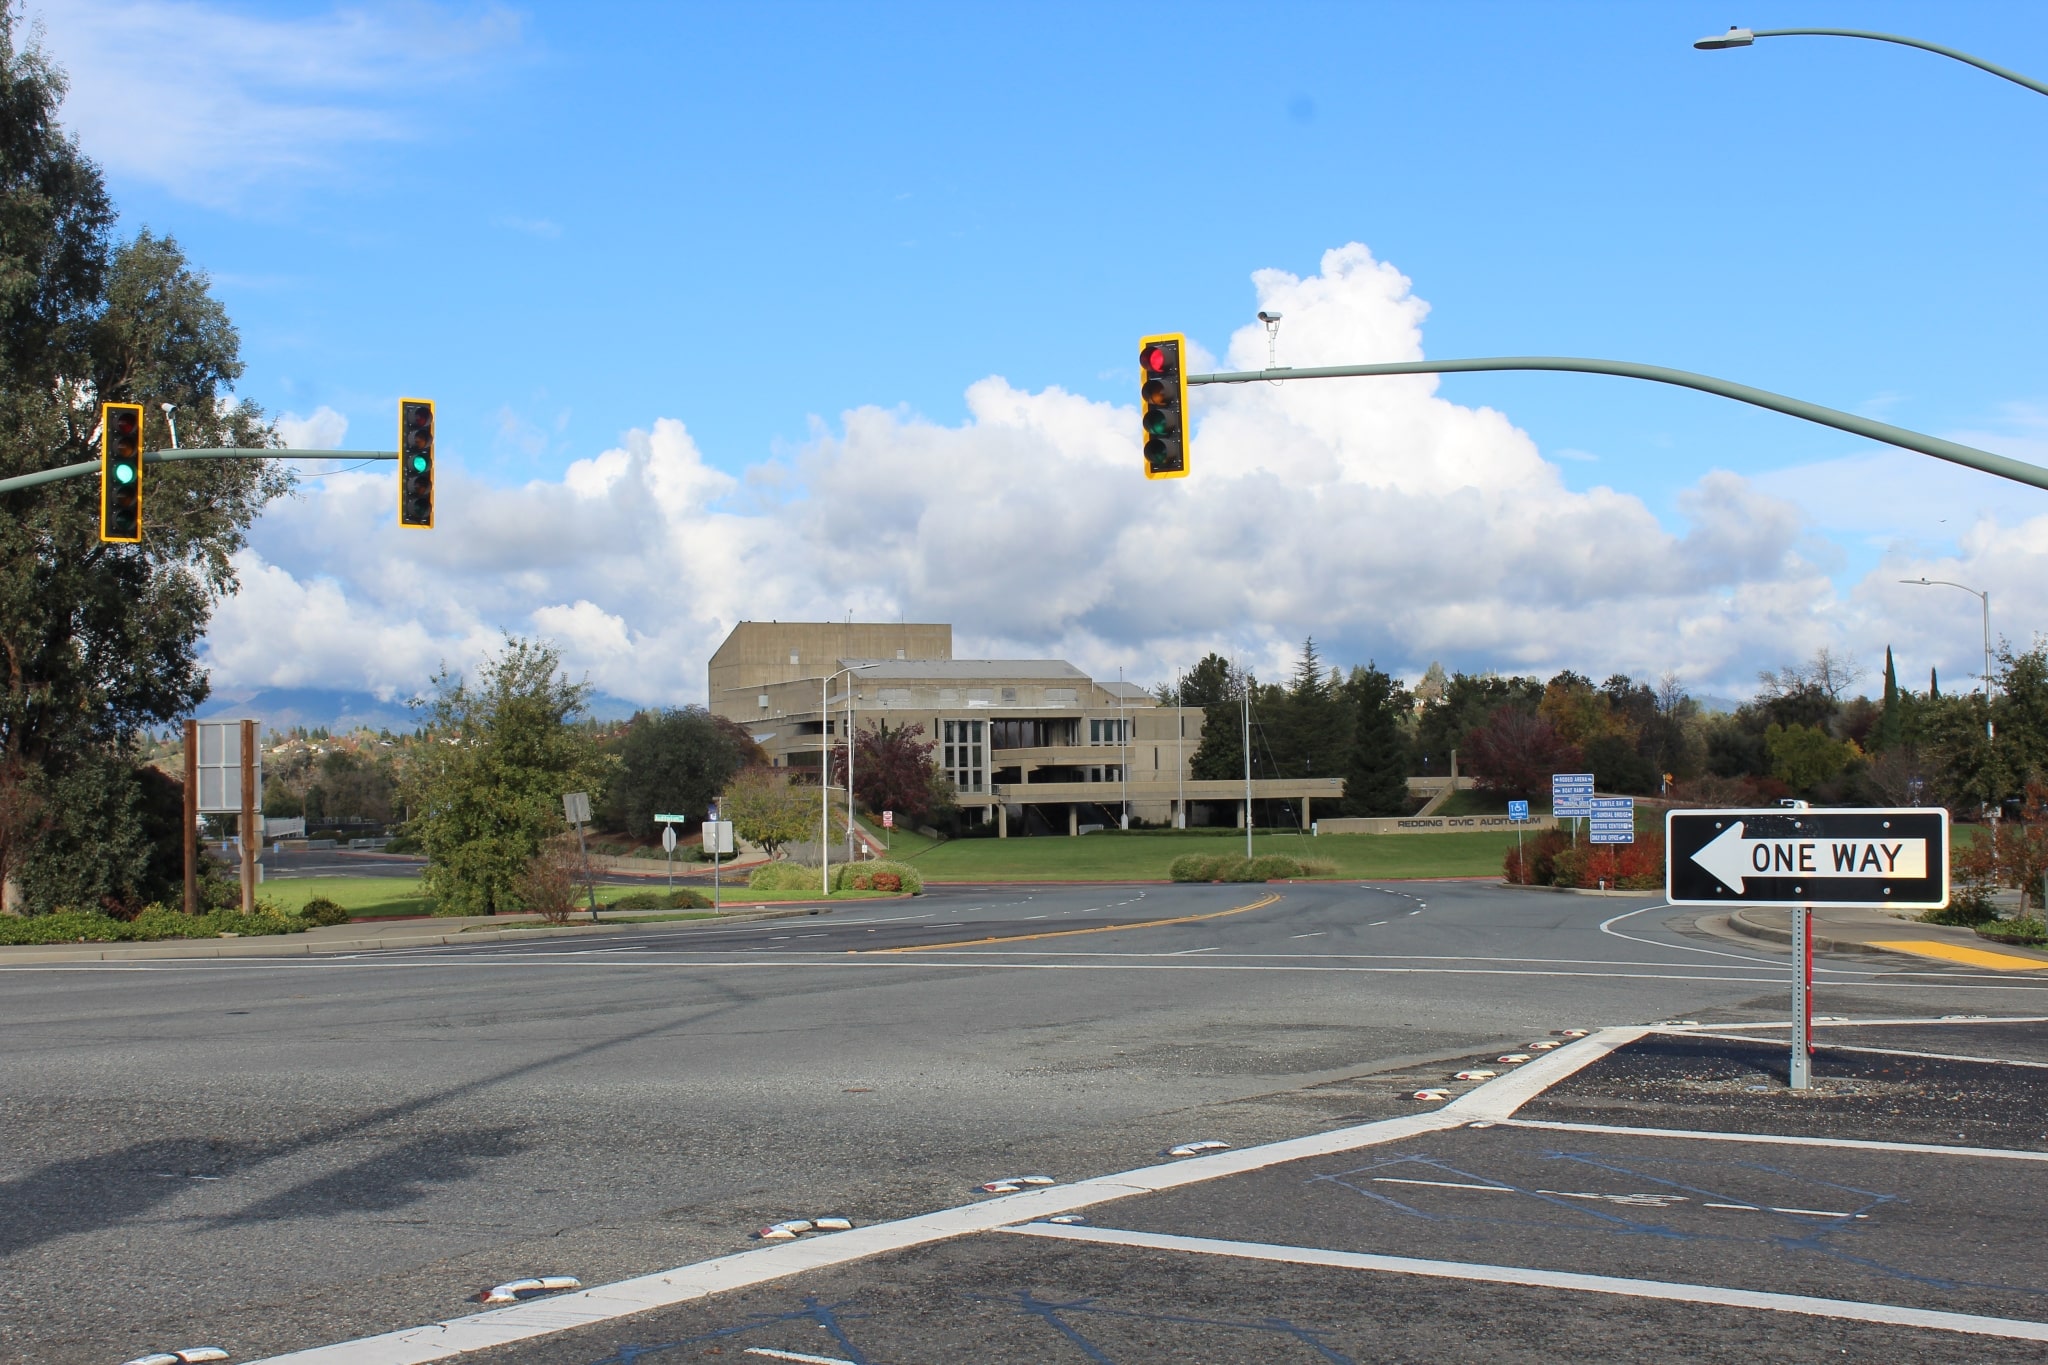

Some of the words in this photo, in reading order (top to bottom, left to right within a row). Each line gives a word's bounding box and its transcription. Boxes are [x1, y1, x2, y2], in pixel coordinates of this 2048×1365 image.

[1480, 817, 1541, 826] AUDITORIUM
[1752, 843, 1816, 872] ONE
[1832, 844, 1903, 872] WAY
